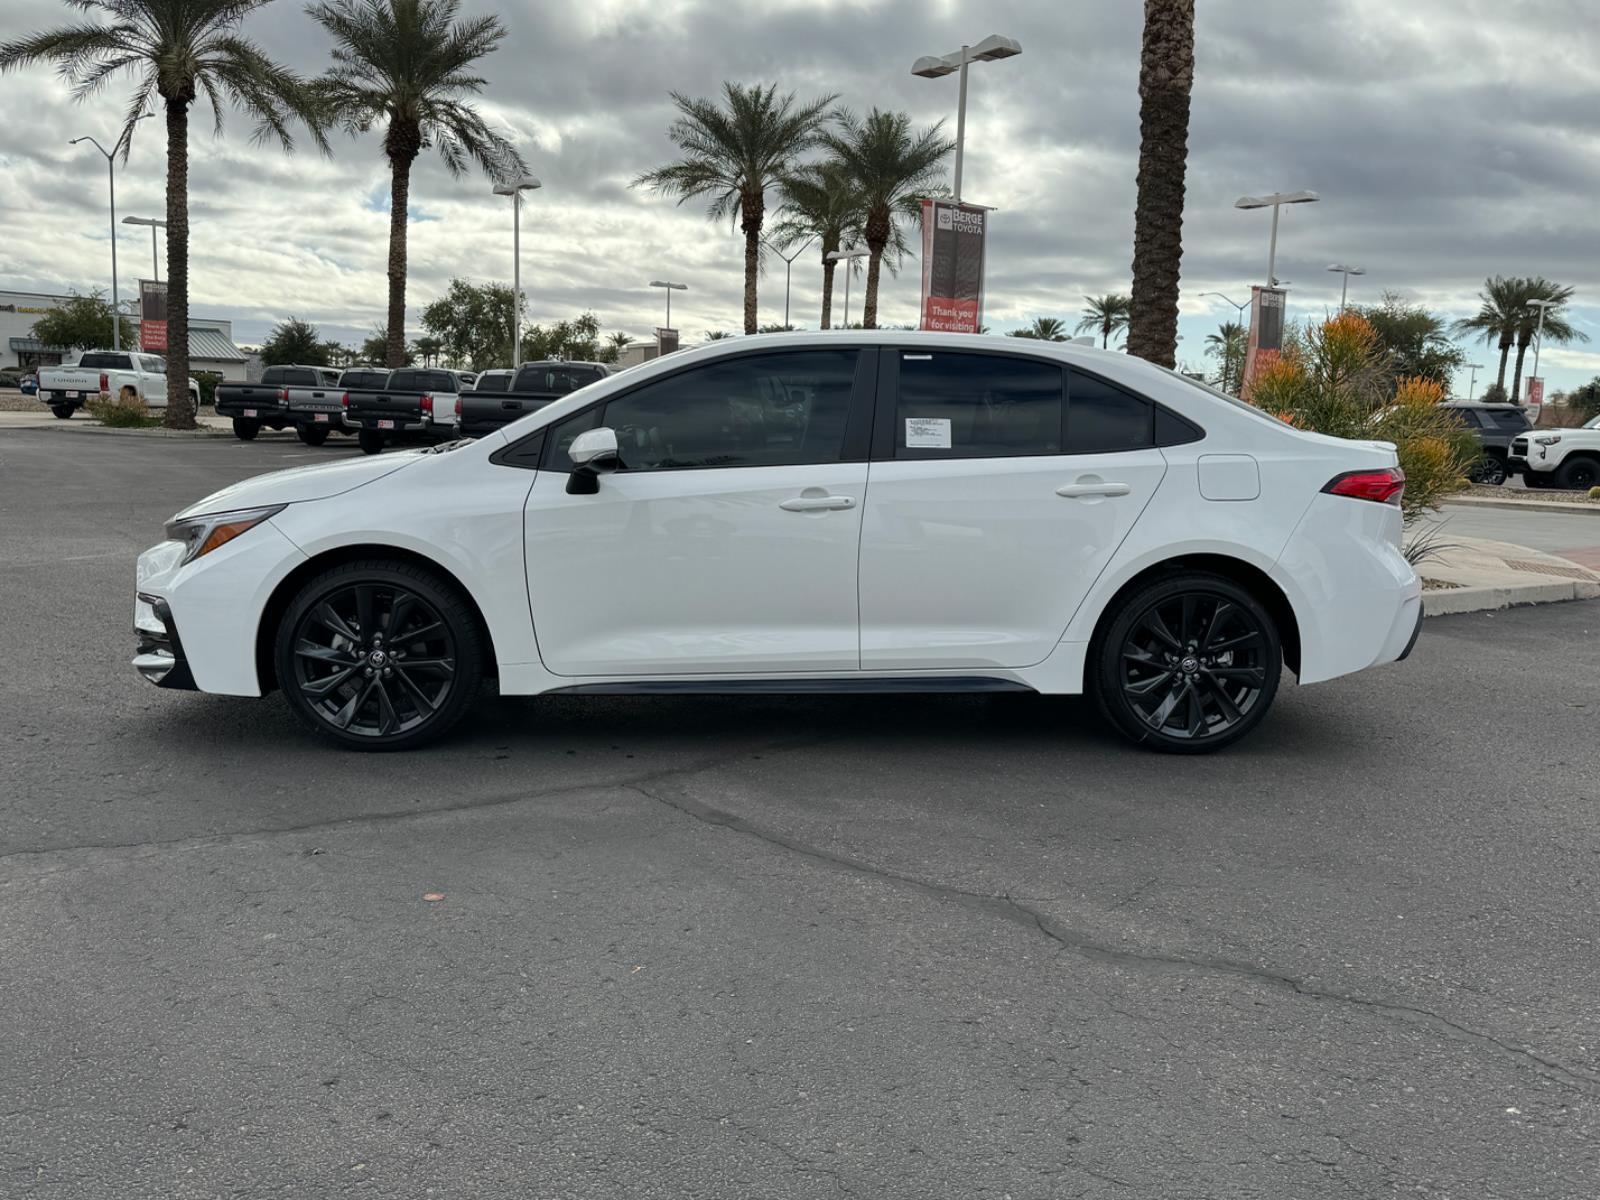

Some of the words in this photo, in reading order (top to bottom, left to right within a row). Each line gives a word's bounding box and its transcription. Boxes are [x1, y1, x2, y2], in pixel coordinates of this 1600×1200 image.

[953, 209, 983, 225] BERGE
[953, 224, 983, 235] TOYOTA
[932, 306, 957, 318] Thank
[958, 310, 974, 320] you
[931, 320, 944, 329] for
[945, 321, 974, 333] visiting
